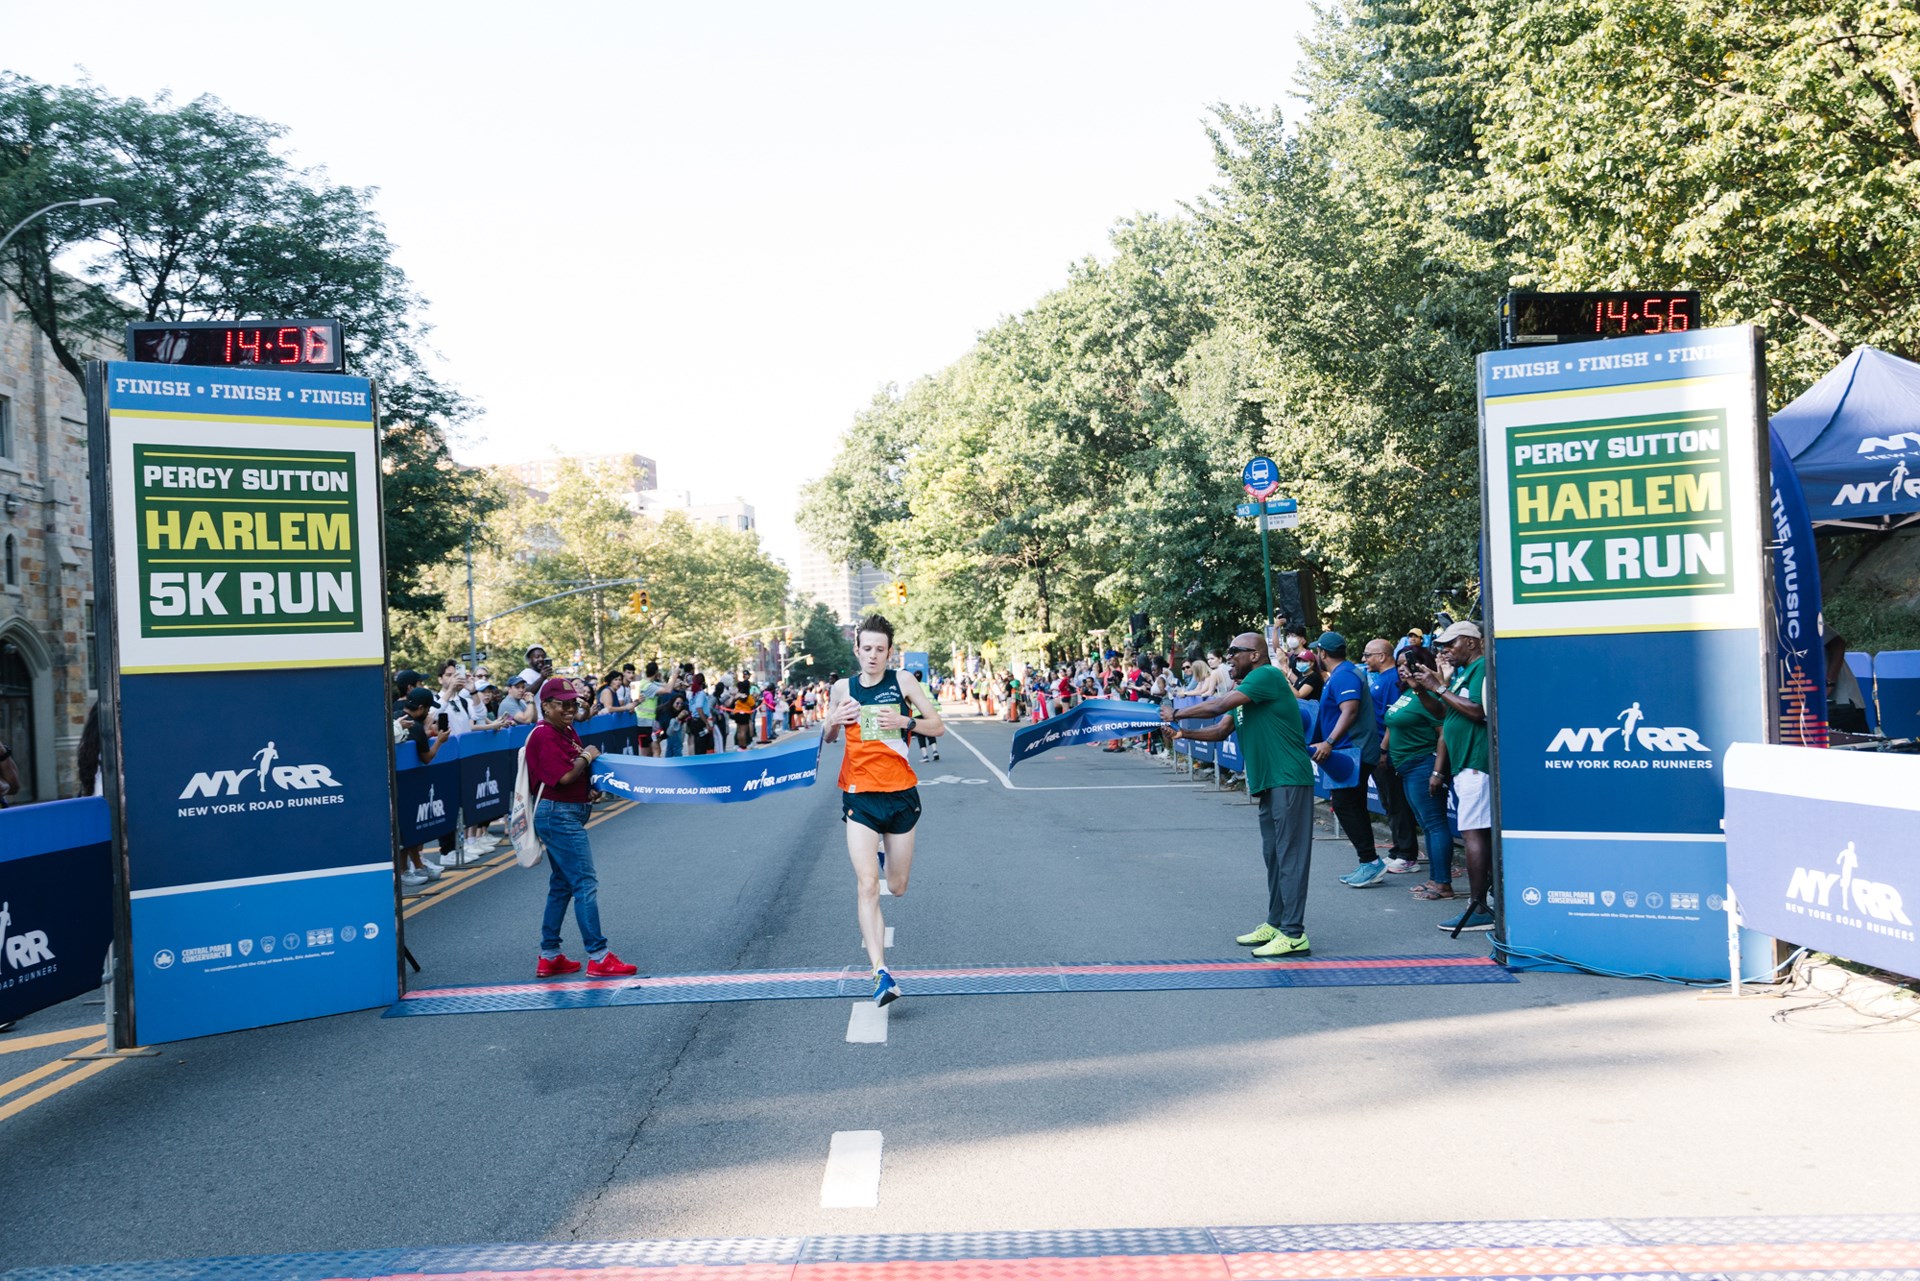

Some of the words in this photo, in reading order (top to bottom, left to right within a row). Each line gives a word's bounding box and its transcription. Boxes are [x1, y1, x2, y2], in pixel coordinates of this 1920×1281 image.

[1491, 360, 1560, 381] FINISH
[1578, 351, 1649, 372] FINISH
[1668, 343, 1715, 363] FINI
[115, 378, 191, 397] FINISH
[210, 384, 282, 402] FINISH
[300, 389, 367, 407] FINISH
[1514, 439, 1600, 467] PERCY
[1607, 428, 1720, 459] SUTTON
[143, 465, 234, 490] PERCY
[241, 468, 348, 492] SUTTON
[1238, 506, 1250, 516] M3
[1516, 471, 1722, 524] HARLEM
[145, 510, 351, 551] HARLEM
[1519, 539, 1594, 585] 5K
[1604, 531, 1725, 581] RUN
[1771, 489, 1792, 543] THE
[1782, 545, 1800, 640] MUSIC
[149, 571, 229, 617] 5K
[240, 571, 354, 614] RUN
[1061, 729, 1080, 737] NEW
[1082, 725, 1103, 735] YORK
[1105, 722, 1128, 731] ROAD
[1545, 726, 1712, 752] NYRR
[1545, 760, 1574, 769] NEW
[1576, 760, 1610, 769] YORK
[1613, 760, 1649, 769] ROAD
[1652, 760, 1713, 769] RUNNERS
[178, 763, 344, 800] NYRR
[633, 786, 653, 794] NEW
[655, 787, 676, 795] YORK
[677, 787, 698, 795] ROAD
[699, 785, 732, 795] RUNNERS
[178, 806, 208, 818] NEW
[211, 802, 246, 815] YORK
[249, 799, 284, 811] ROAD
[287, 794, 344, 808] RUNNERS
[1785, 902, 1804, 915] NEW
[1808, 908, 1832, 922] YORK
[1835, 914, 1862, 928] ROAD
[1866, 920, 1915, 942] RUNNERS
[18, 963, 58, 984] RUNNERS
